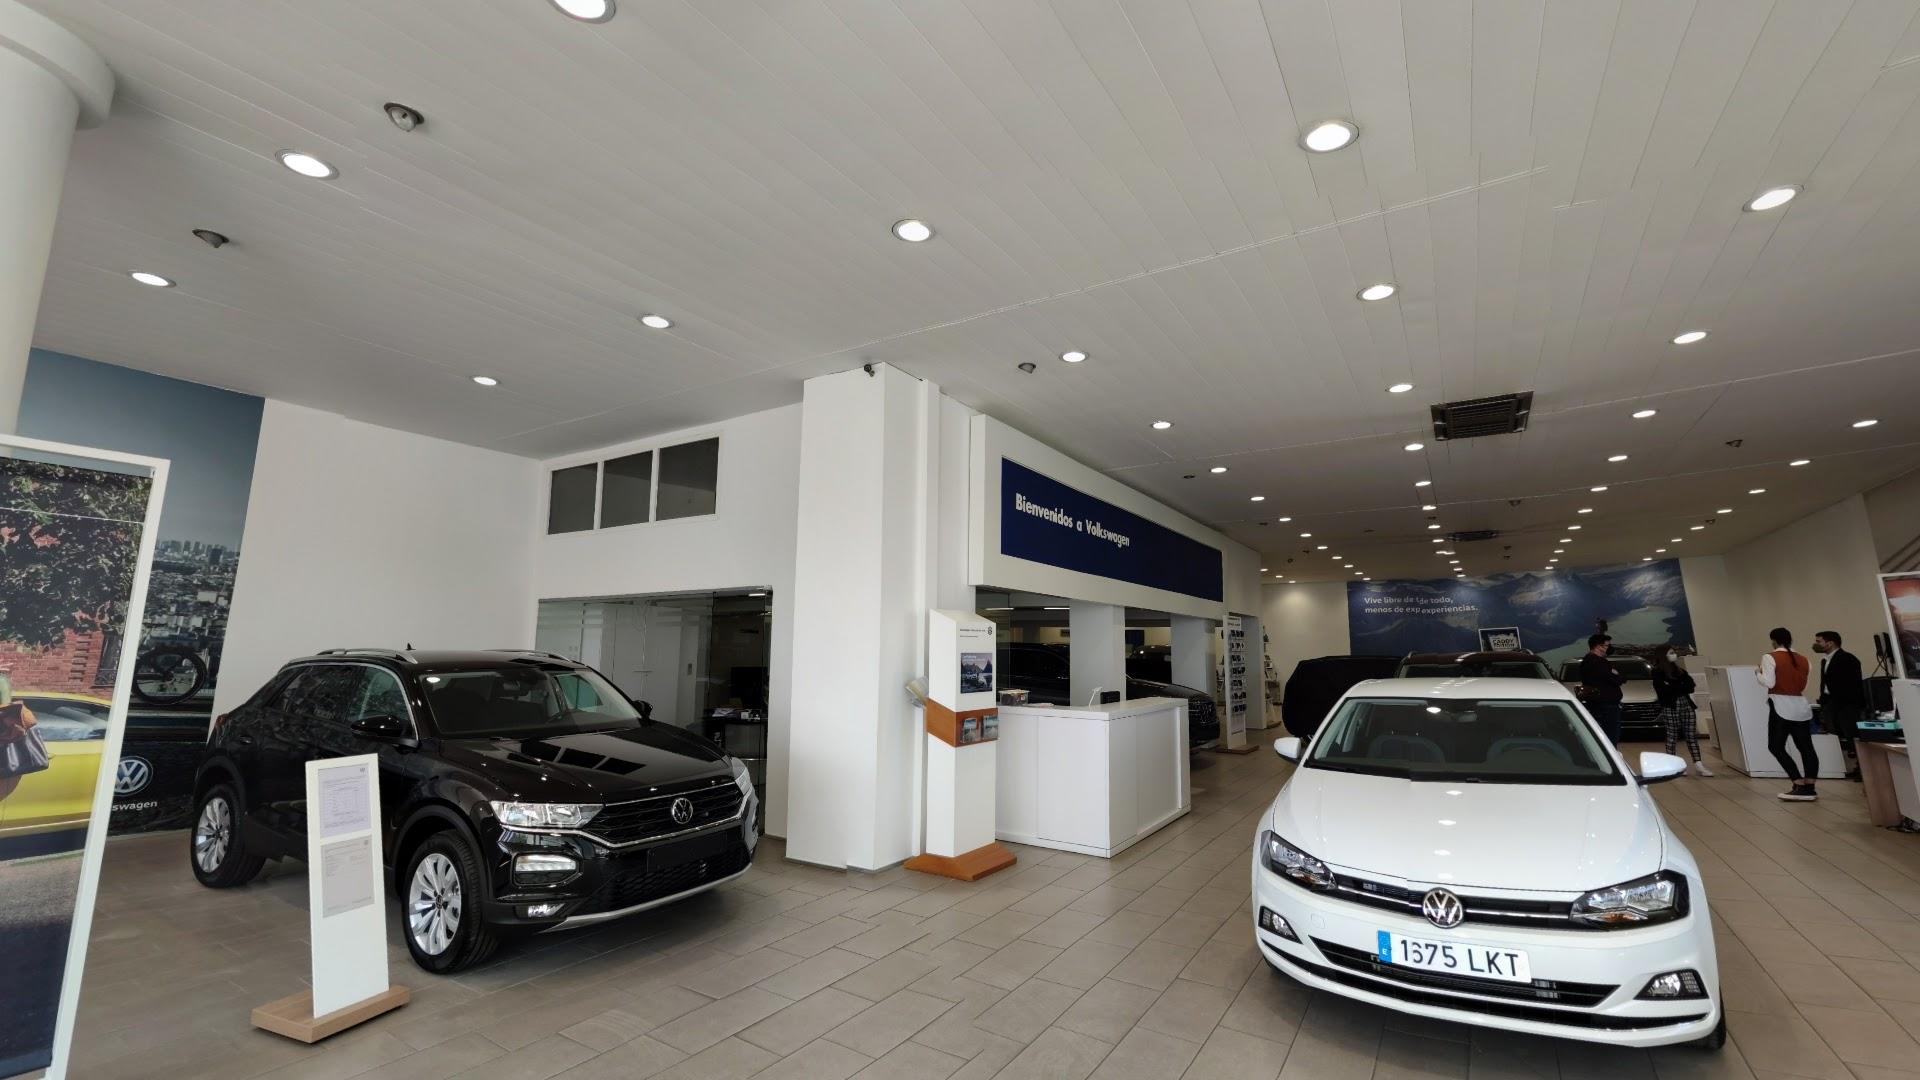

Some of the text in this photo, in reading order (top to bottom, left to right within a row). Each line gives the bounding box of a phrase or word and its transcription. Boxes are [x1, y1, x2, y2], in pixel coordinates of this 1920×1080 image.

[1015, 492, 1130, 548] Bienvenidos a Volkswagen
[1364, 596, 1382, 604] Vive
[1383, 596, 1402, 604] libre
[1365, 606, 1392, 614] menos
[1394, 605, 1404, 613] de
[112, 801, 158, 812] swagen
[1467, 948, 1519, 977] LKT
